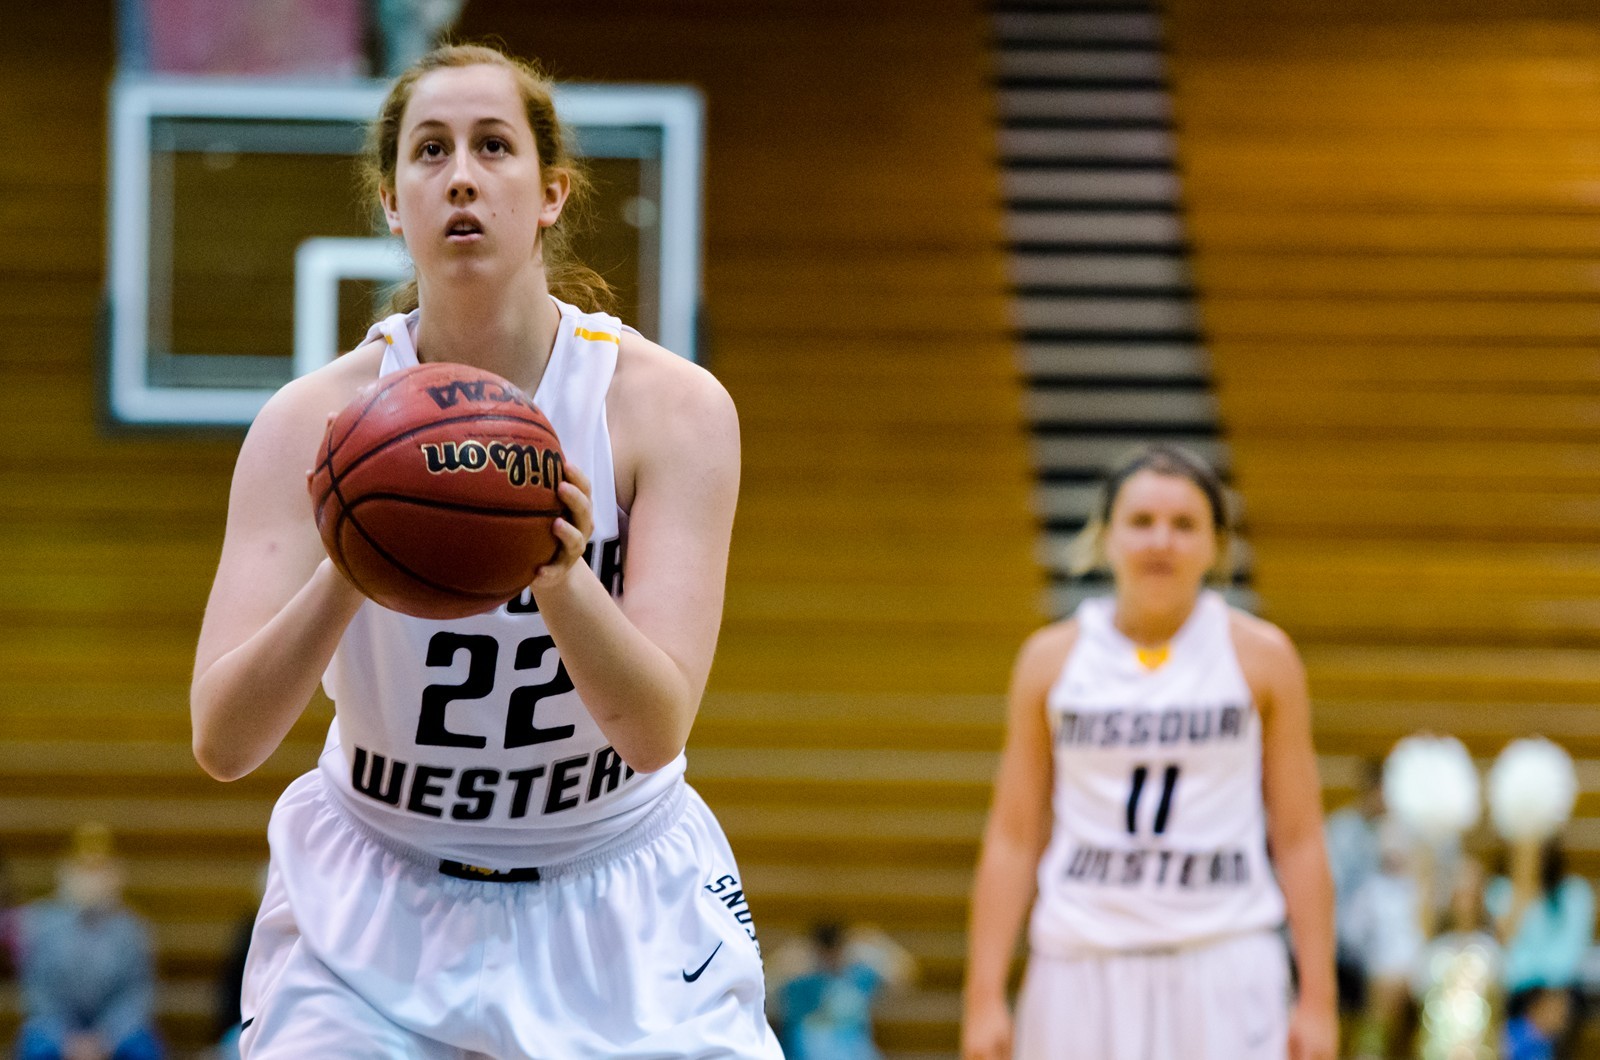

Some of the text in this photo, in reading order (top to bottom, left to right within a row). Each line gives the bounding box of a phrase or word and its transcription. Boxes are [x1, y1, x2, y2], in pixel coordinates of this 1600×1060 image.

[421, 439, 566, 493] Wilson
[415, 631, 576, 749] 22
[351, 744, 635, 821] WESTER
[1126, 765, 1181, 835] 11
